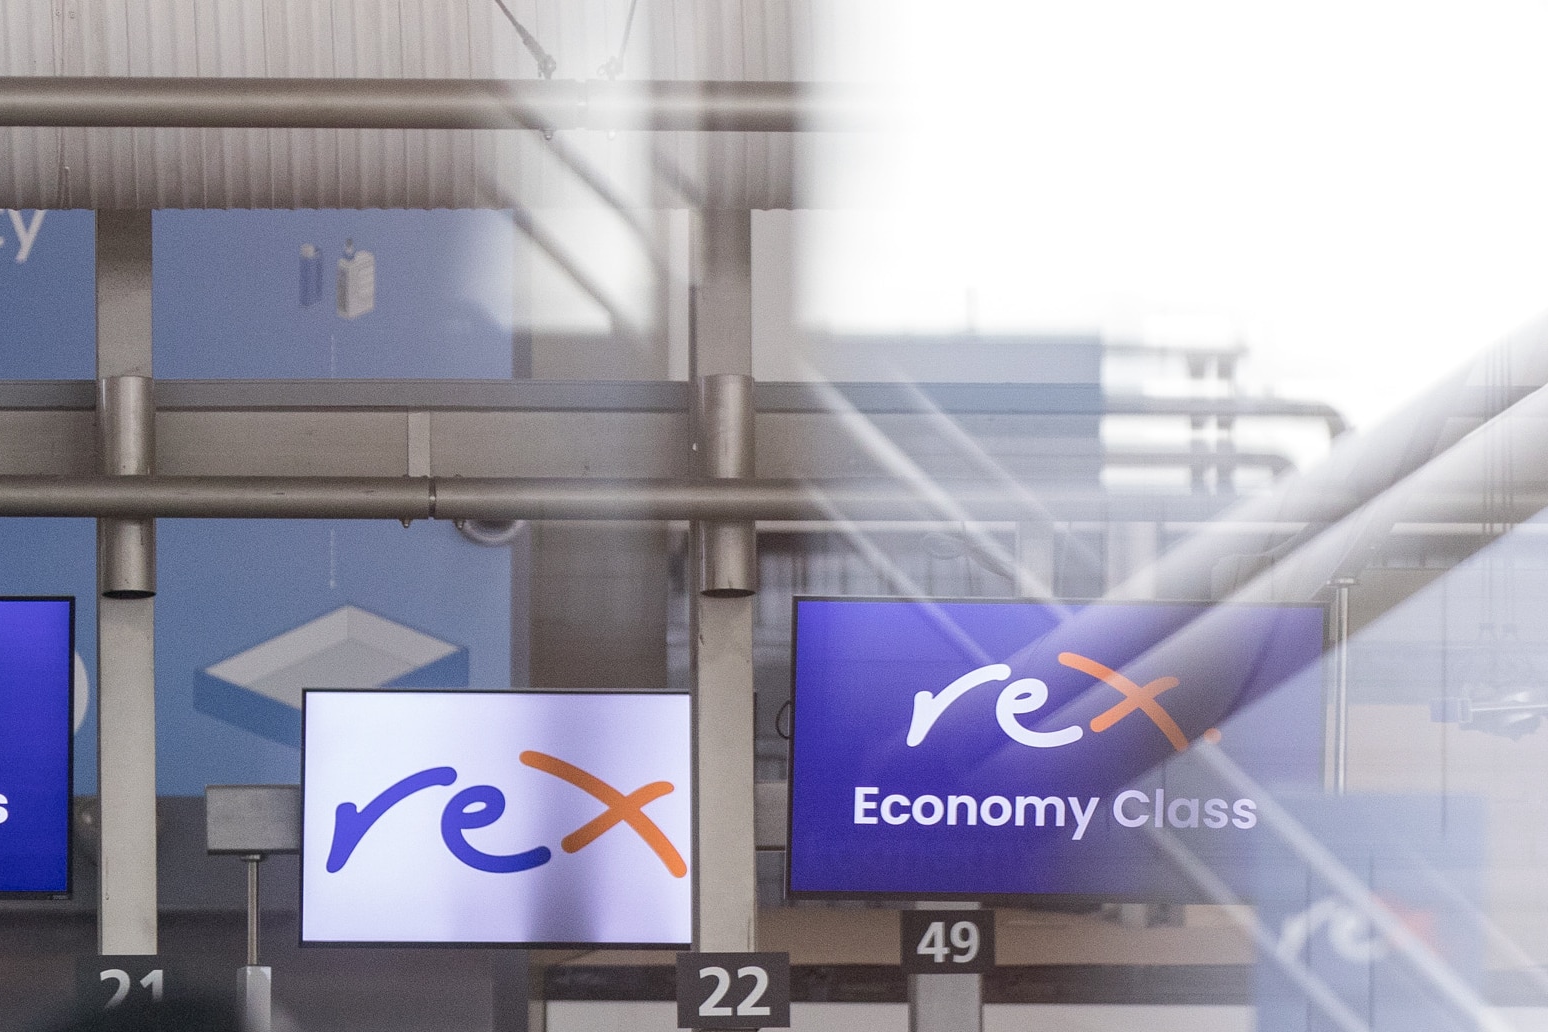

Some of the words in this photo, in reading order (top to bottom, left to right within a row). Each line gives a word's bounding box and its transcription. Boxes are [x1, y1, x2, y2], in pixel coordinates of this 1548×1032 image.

[326, 750, 688, 878] rex
[853, 786, 1100, 840] Economy
[1114, 788, 1257, 828] Class
[917, 921, 982, 964] 49
[100, 968, 163, 1010] 21
[698, 966, 771, 1017] 22
